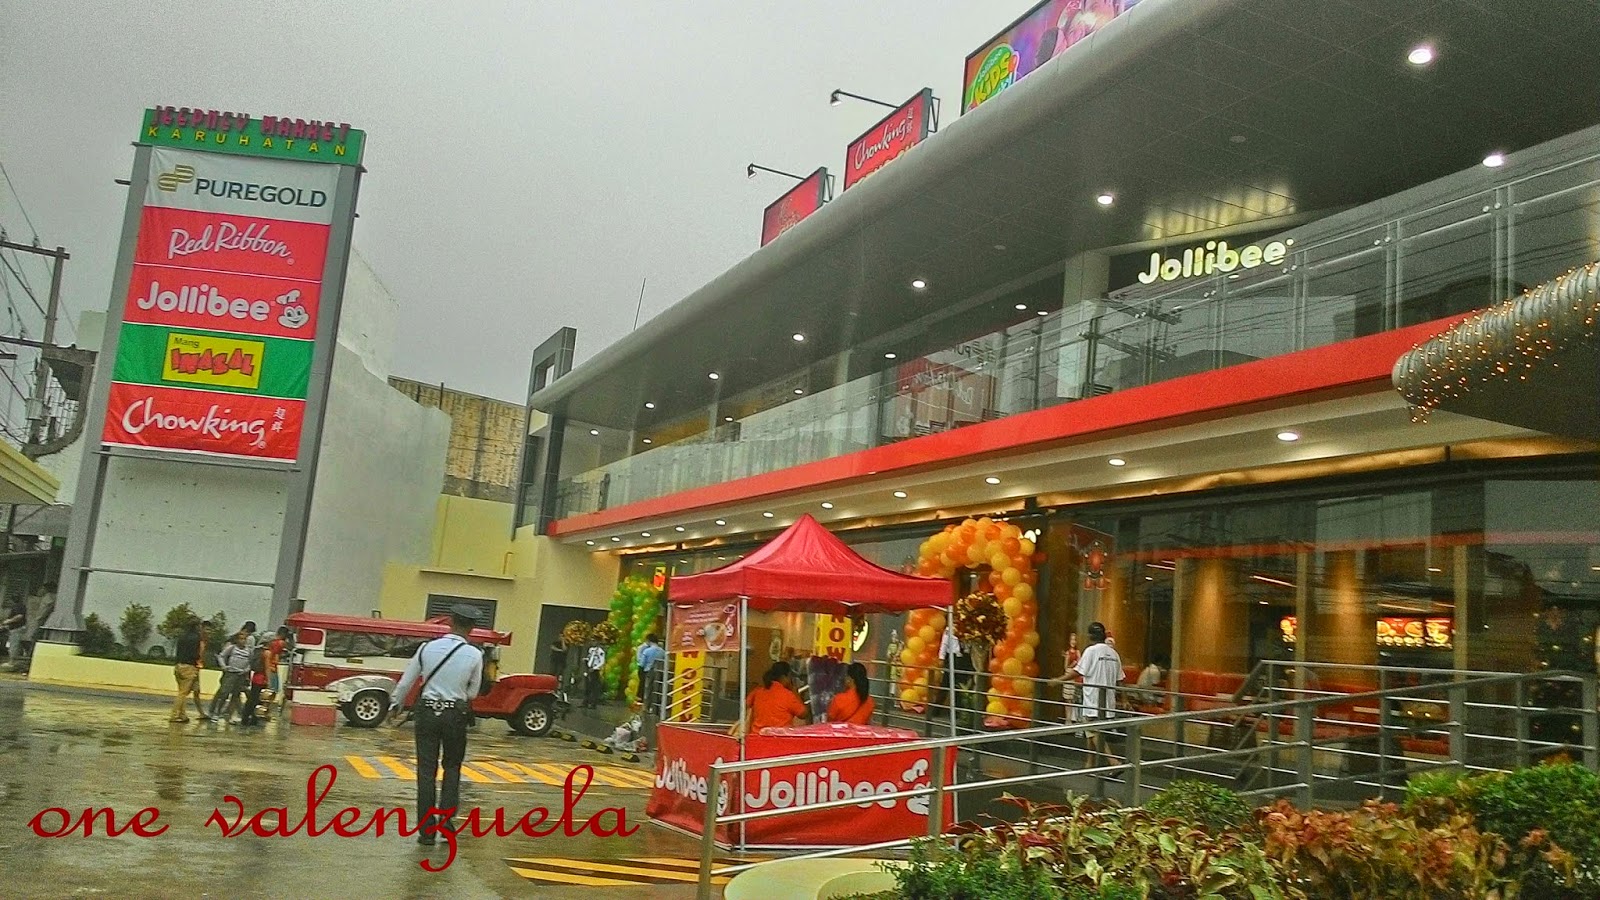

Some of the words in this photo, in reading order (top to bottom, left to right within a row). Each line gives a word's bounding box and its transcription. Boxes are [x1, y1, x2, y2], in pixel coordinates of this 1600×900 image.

[149, 126, 346, 156] KARUHATAN
[153, 105, 250, 131] JEEPNEY
[261, 115, 351, 143] MARKET
[855, 119, 906, 170] Chowking
[194, 178, 327, 208] PUREGOLD
[168, 224, 215, 260] Red
[214, 222, 292, 258] Ribbon
[1138, 240, 1287, 284] Jollibee
[137, 281, 270, 321] Jollibee
[174, 337, 200, 349] Mang
[122, 396, 265, 446] Chowking
[656, 755, 708, 803] Jollibee
[745, 767, 897, 808] Jollibee
